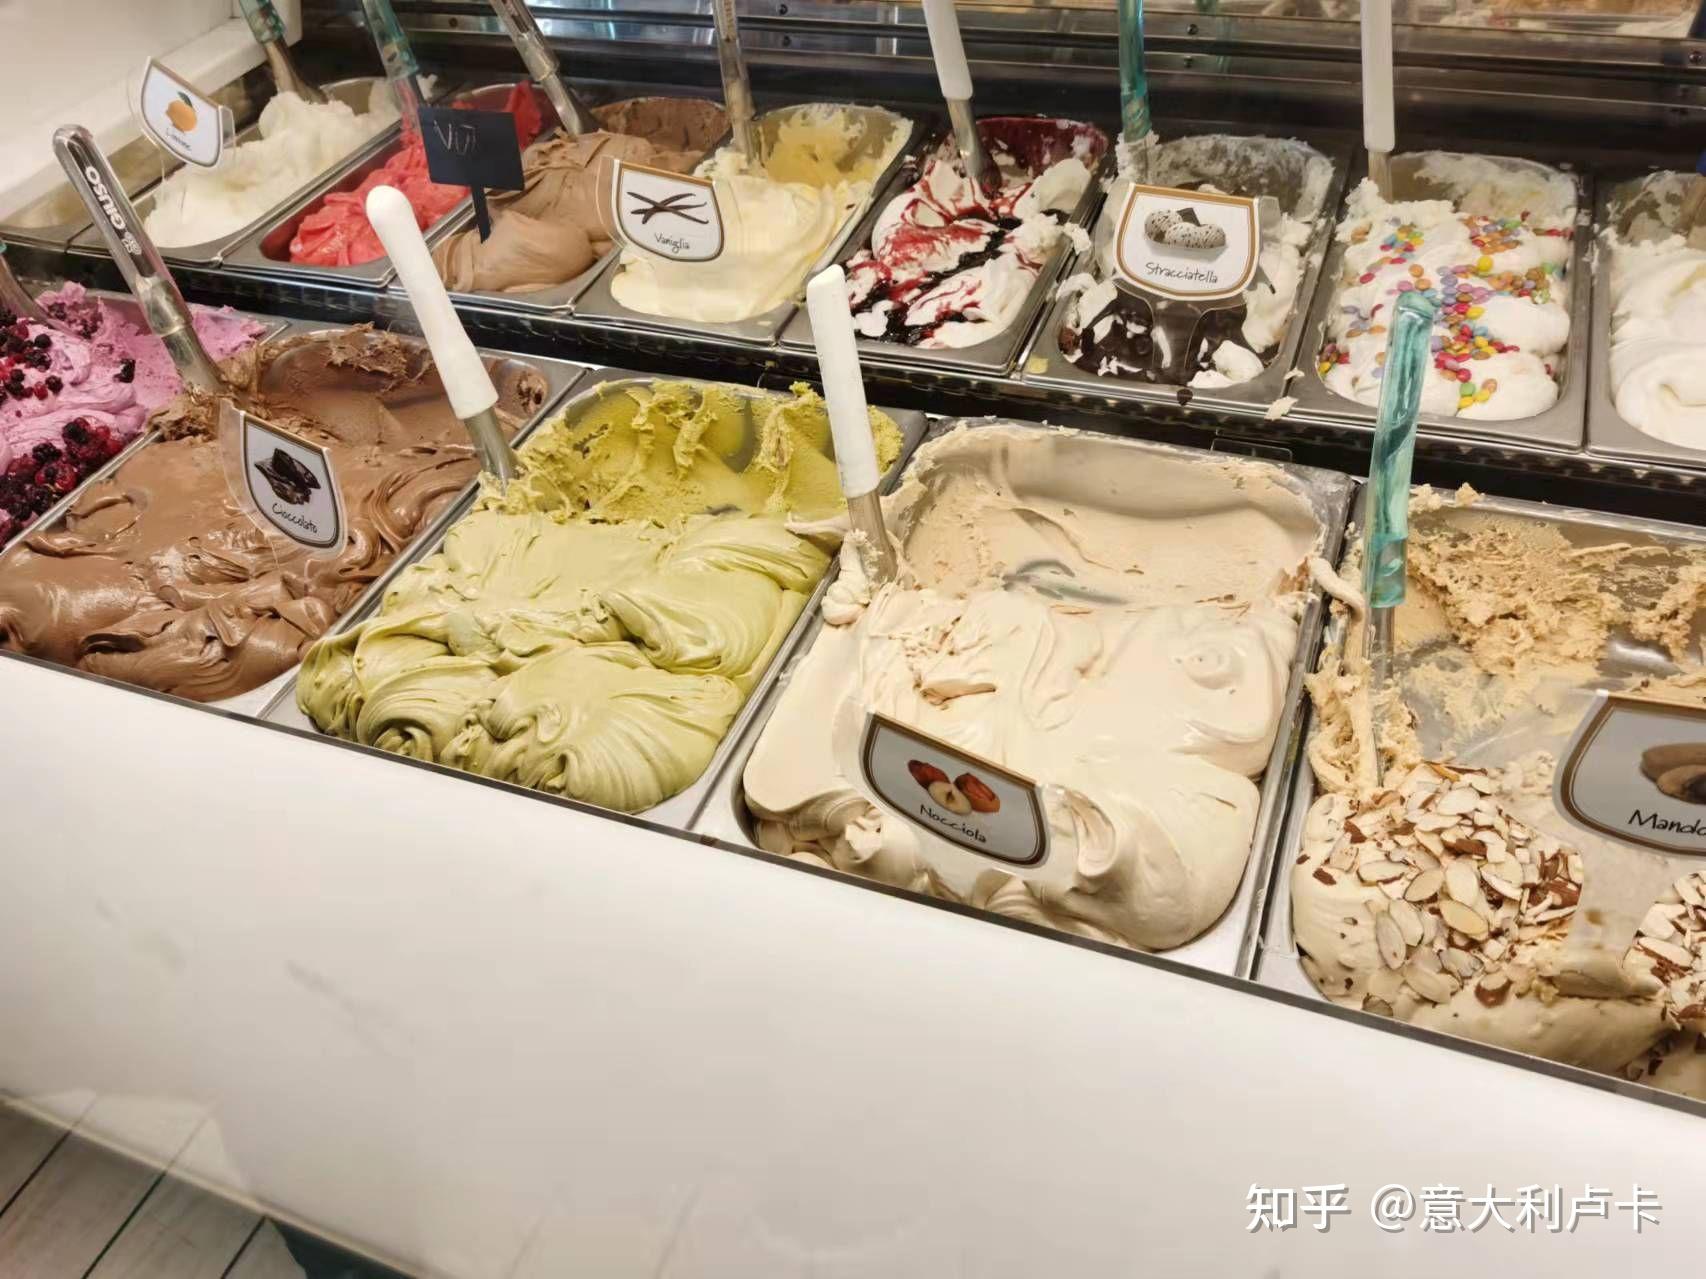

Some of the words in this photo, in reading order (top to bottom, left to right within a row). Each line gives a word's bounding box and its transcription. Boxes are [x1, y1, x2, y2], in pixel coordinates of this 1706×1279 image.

[85, 165, 126, 230] GIUSO
[654, 232, 690, 254] Vaniglia
[1145, 262, 1219, 284] Stracciatella
[920, 804, 987, 843] Nocciola
